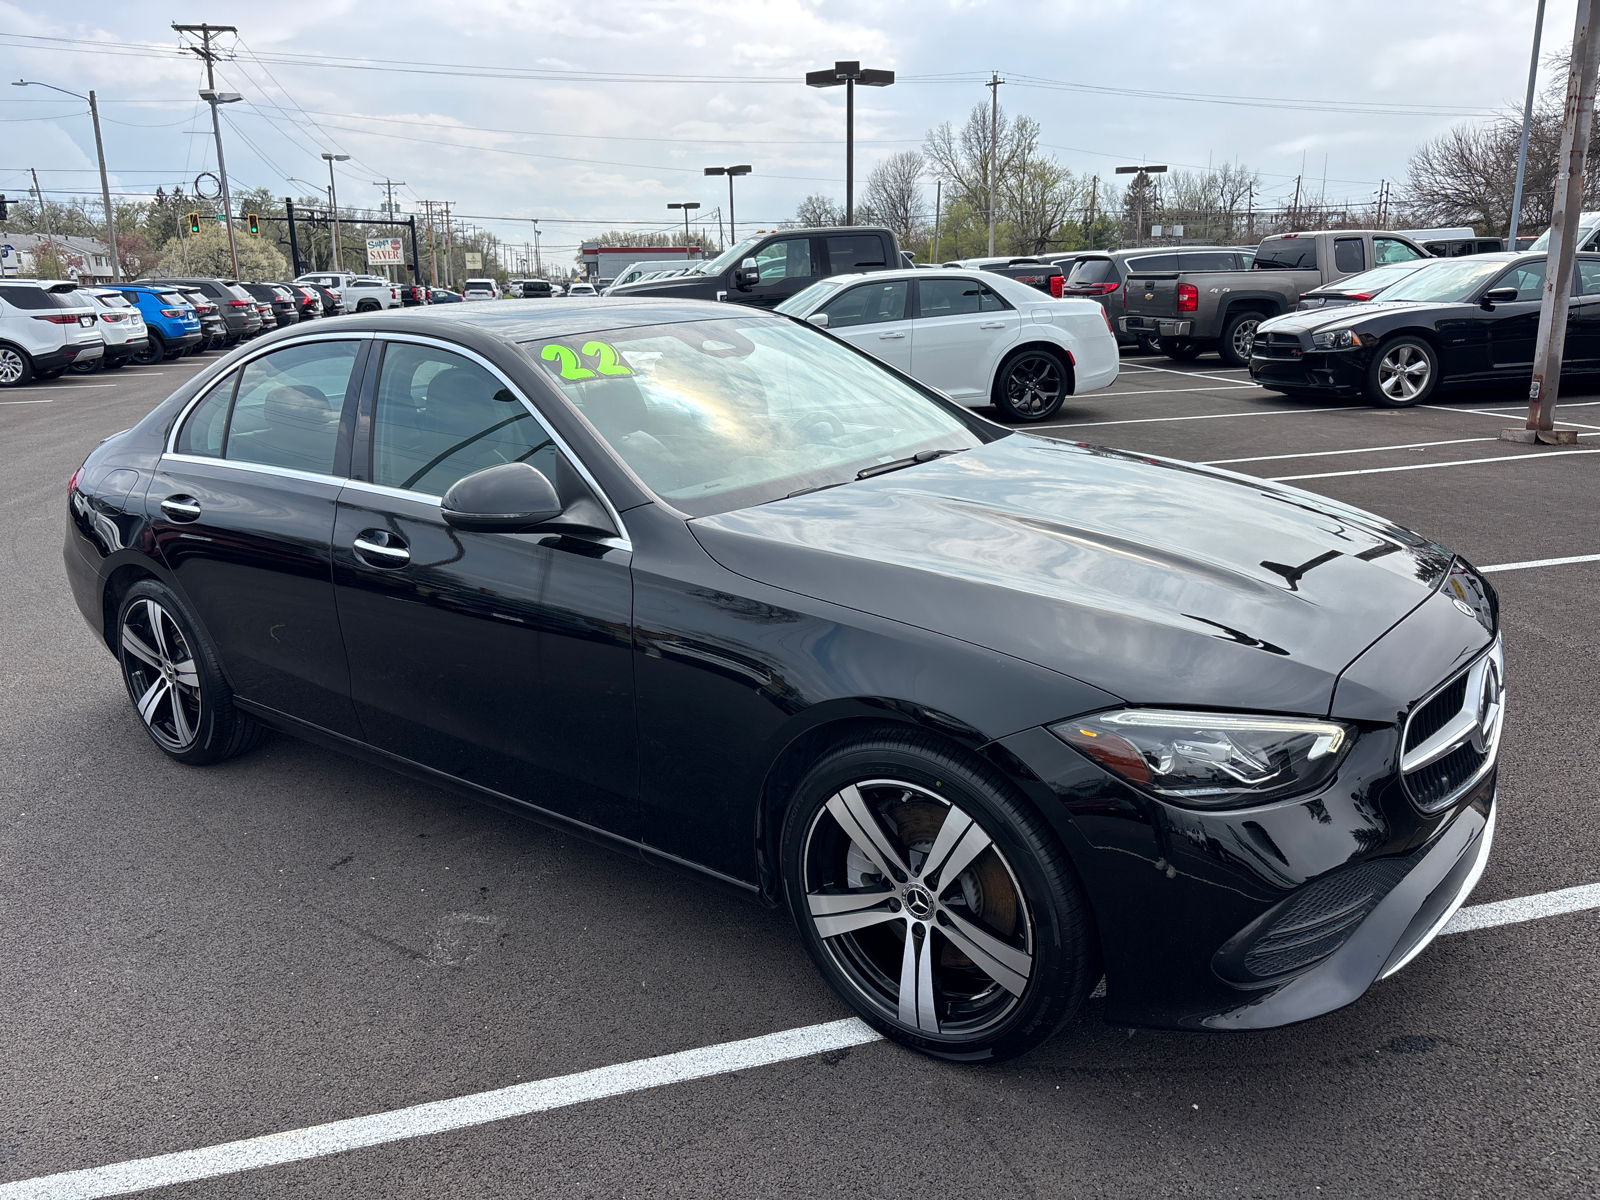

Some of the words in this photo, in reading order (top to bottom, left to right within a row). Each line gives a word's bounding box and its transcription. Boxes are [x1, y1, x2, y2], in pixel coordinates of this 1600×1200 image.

[367, 239, 390, 250] Super
[370, 250, 399, 260] SAVER
[540, 340, 635, 380] 22
